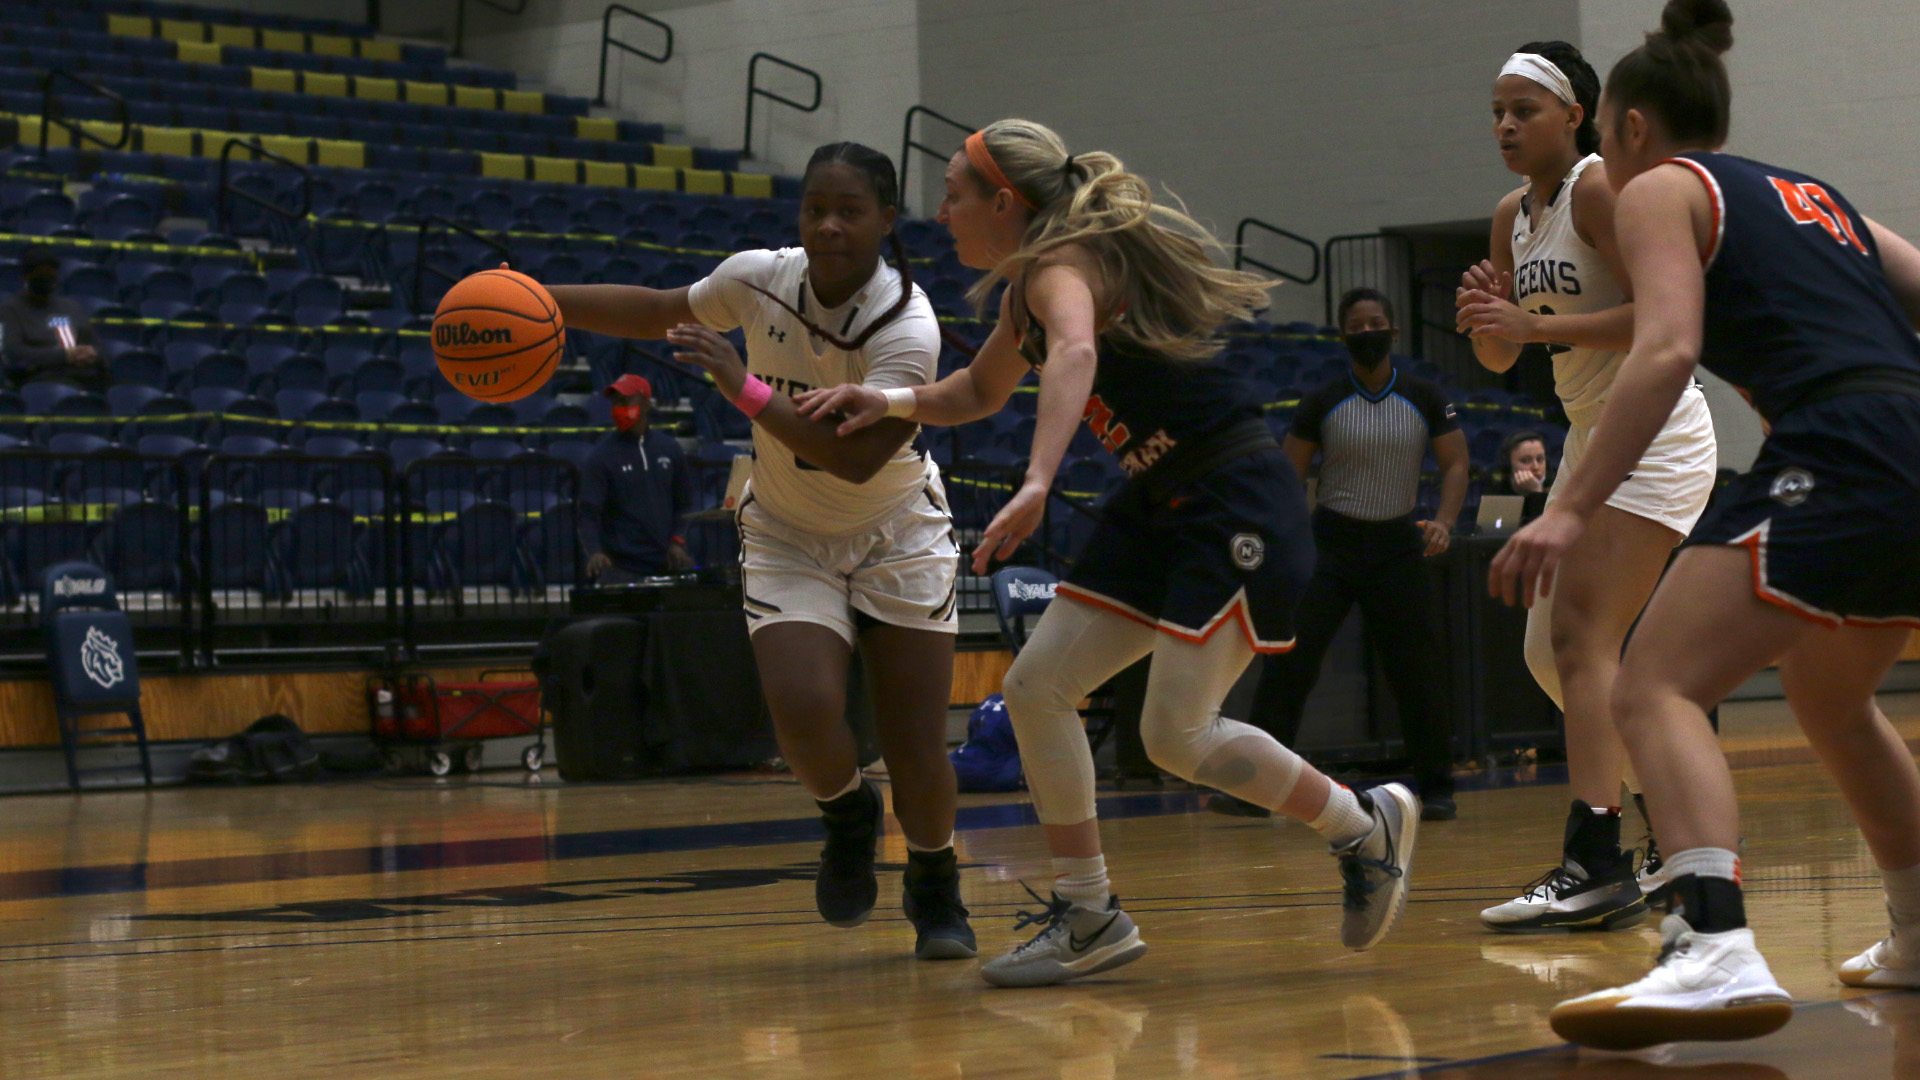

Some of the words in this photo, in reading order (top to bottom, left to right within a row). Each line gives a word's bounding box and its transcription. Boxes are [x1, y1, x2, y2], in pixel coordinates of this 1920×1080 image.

[1766, 175, 1869, 256] 47
[1514, 260, 1582, 300] EENS
[435, 322, 513, 348] Wilson
